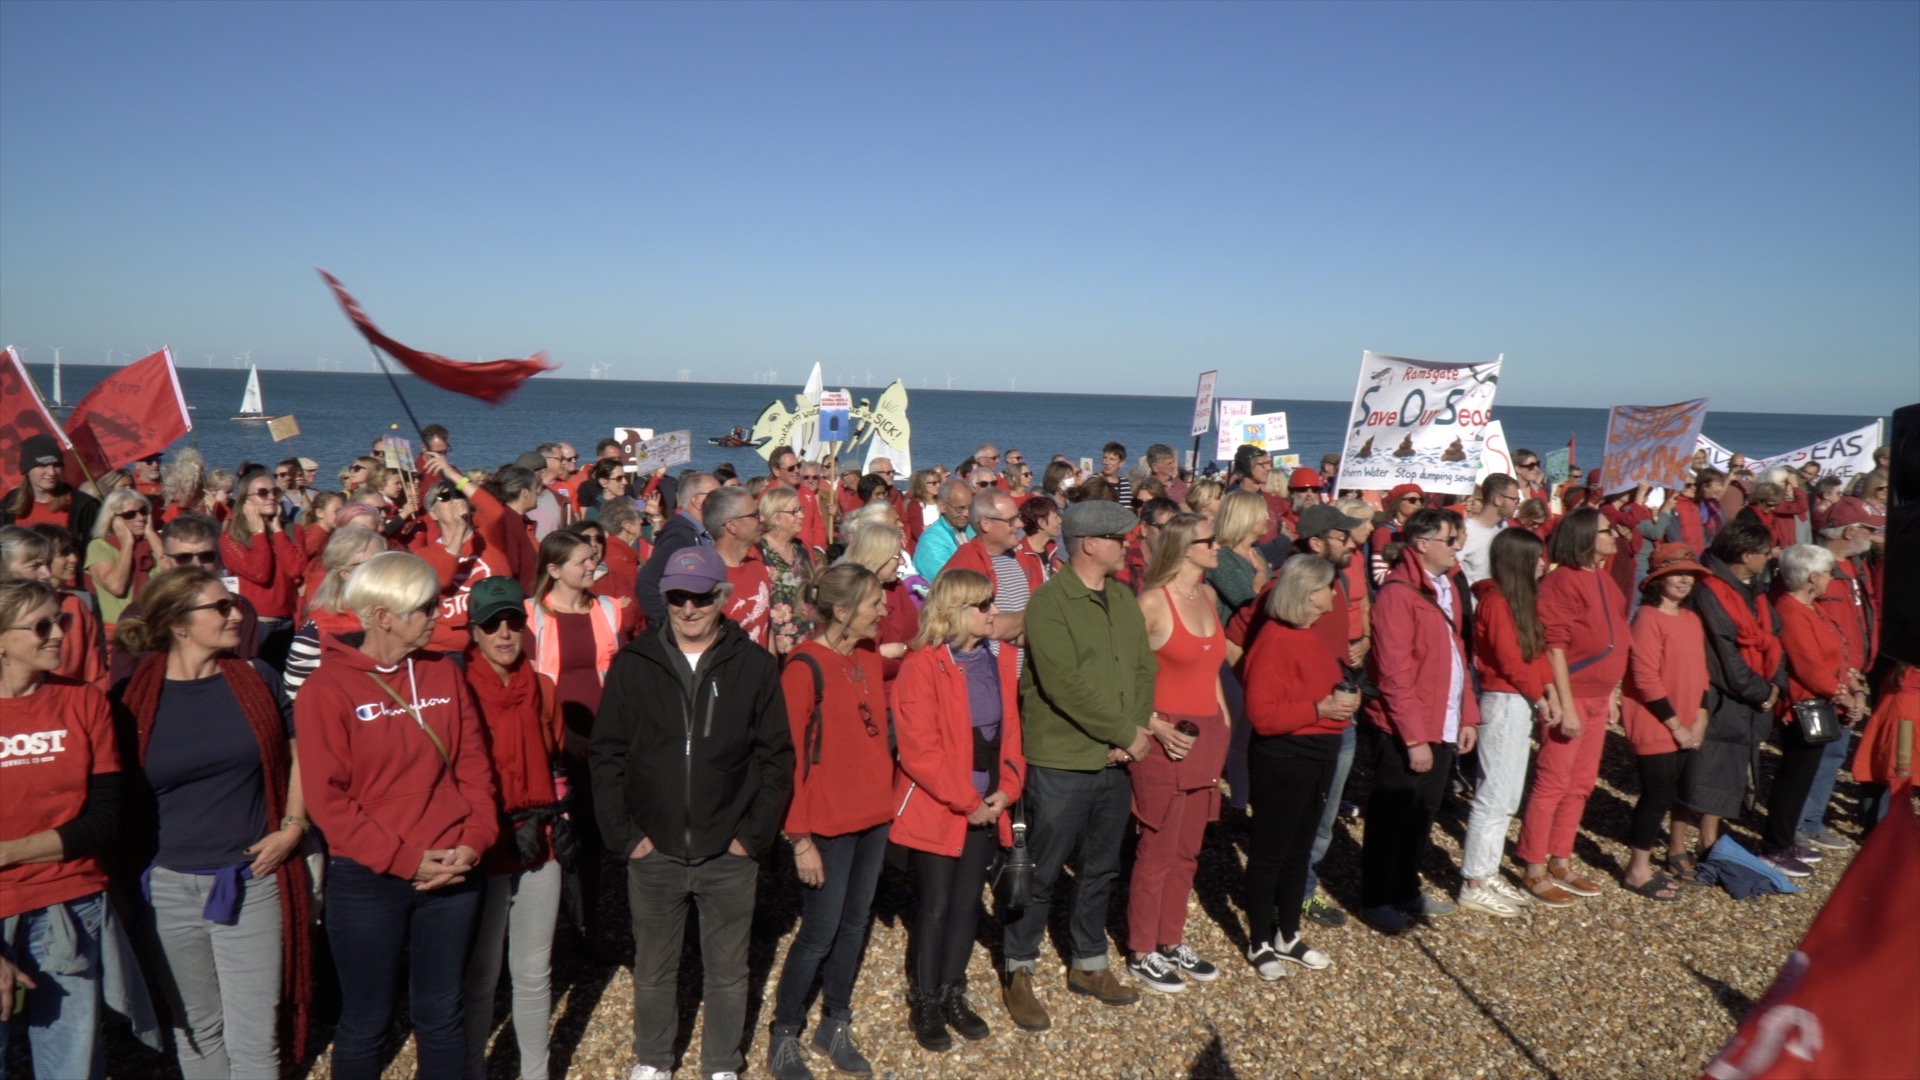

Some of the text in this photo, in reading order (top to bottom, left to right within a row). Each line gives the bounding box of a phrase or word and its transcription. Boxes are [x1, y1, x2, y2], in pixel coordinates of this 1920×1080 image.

[1402, 366, 1460, 385] Ramsgate
[1353, 385, 1491, 428] Save Our Seas
[776, 413, 802, 447] outhern
[873, 413, 903, 441] SICK!
[1365, 467, 1390, 478] Water
[1395, 467, 1417, 484] Stop
[1419, 468, 1453, 486] dumping
